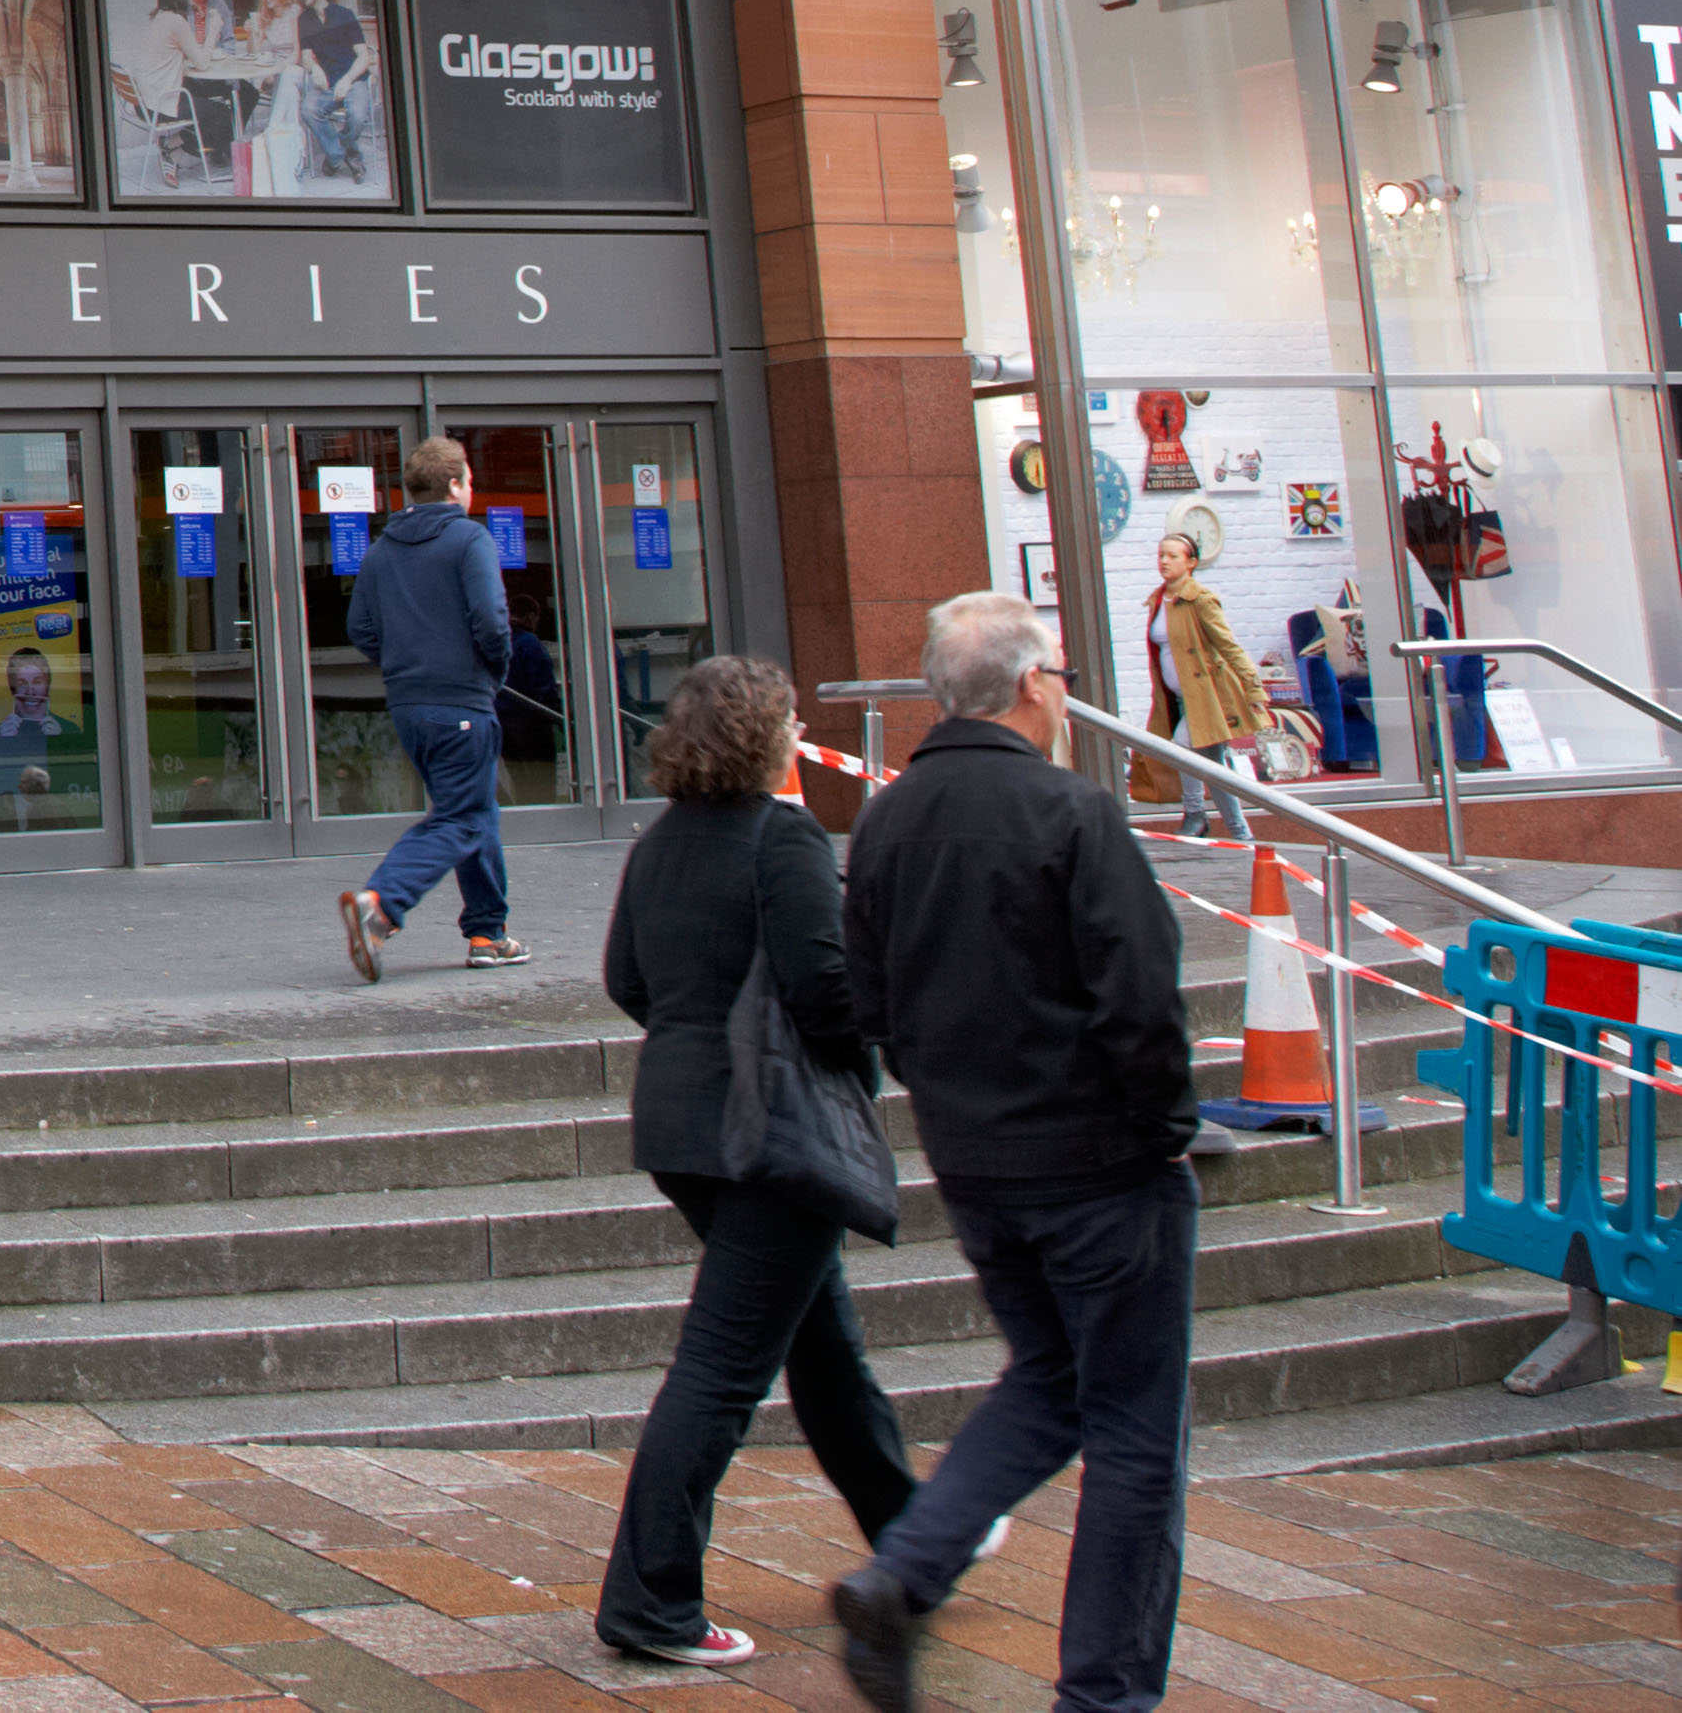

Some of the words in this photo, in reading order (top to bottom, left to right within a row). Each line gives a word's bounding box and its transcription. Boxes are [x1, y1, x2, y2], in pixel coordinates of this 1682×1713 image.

[504, 88, 575, 108] Scotland
[578, 90, 615, 109] with
[38, 615, 69, 631] Real
